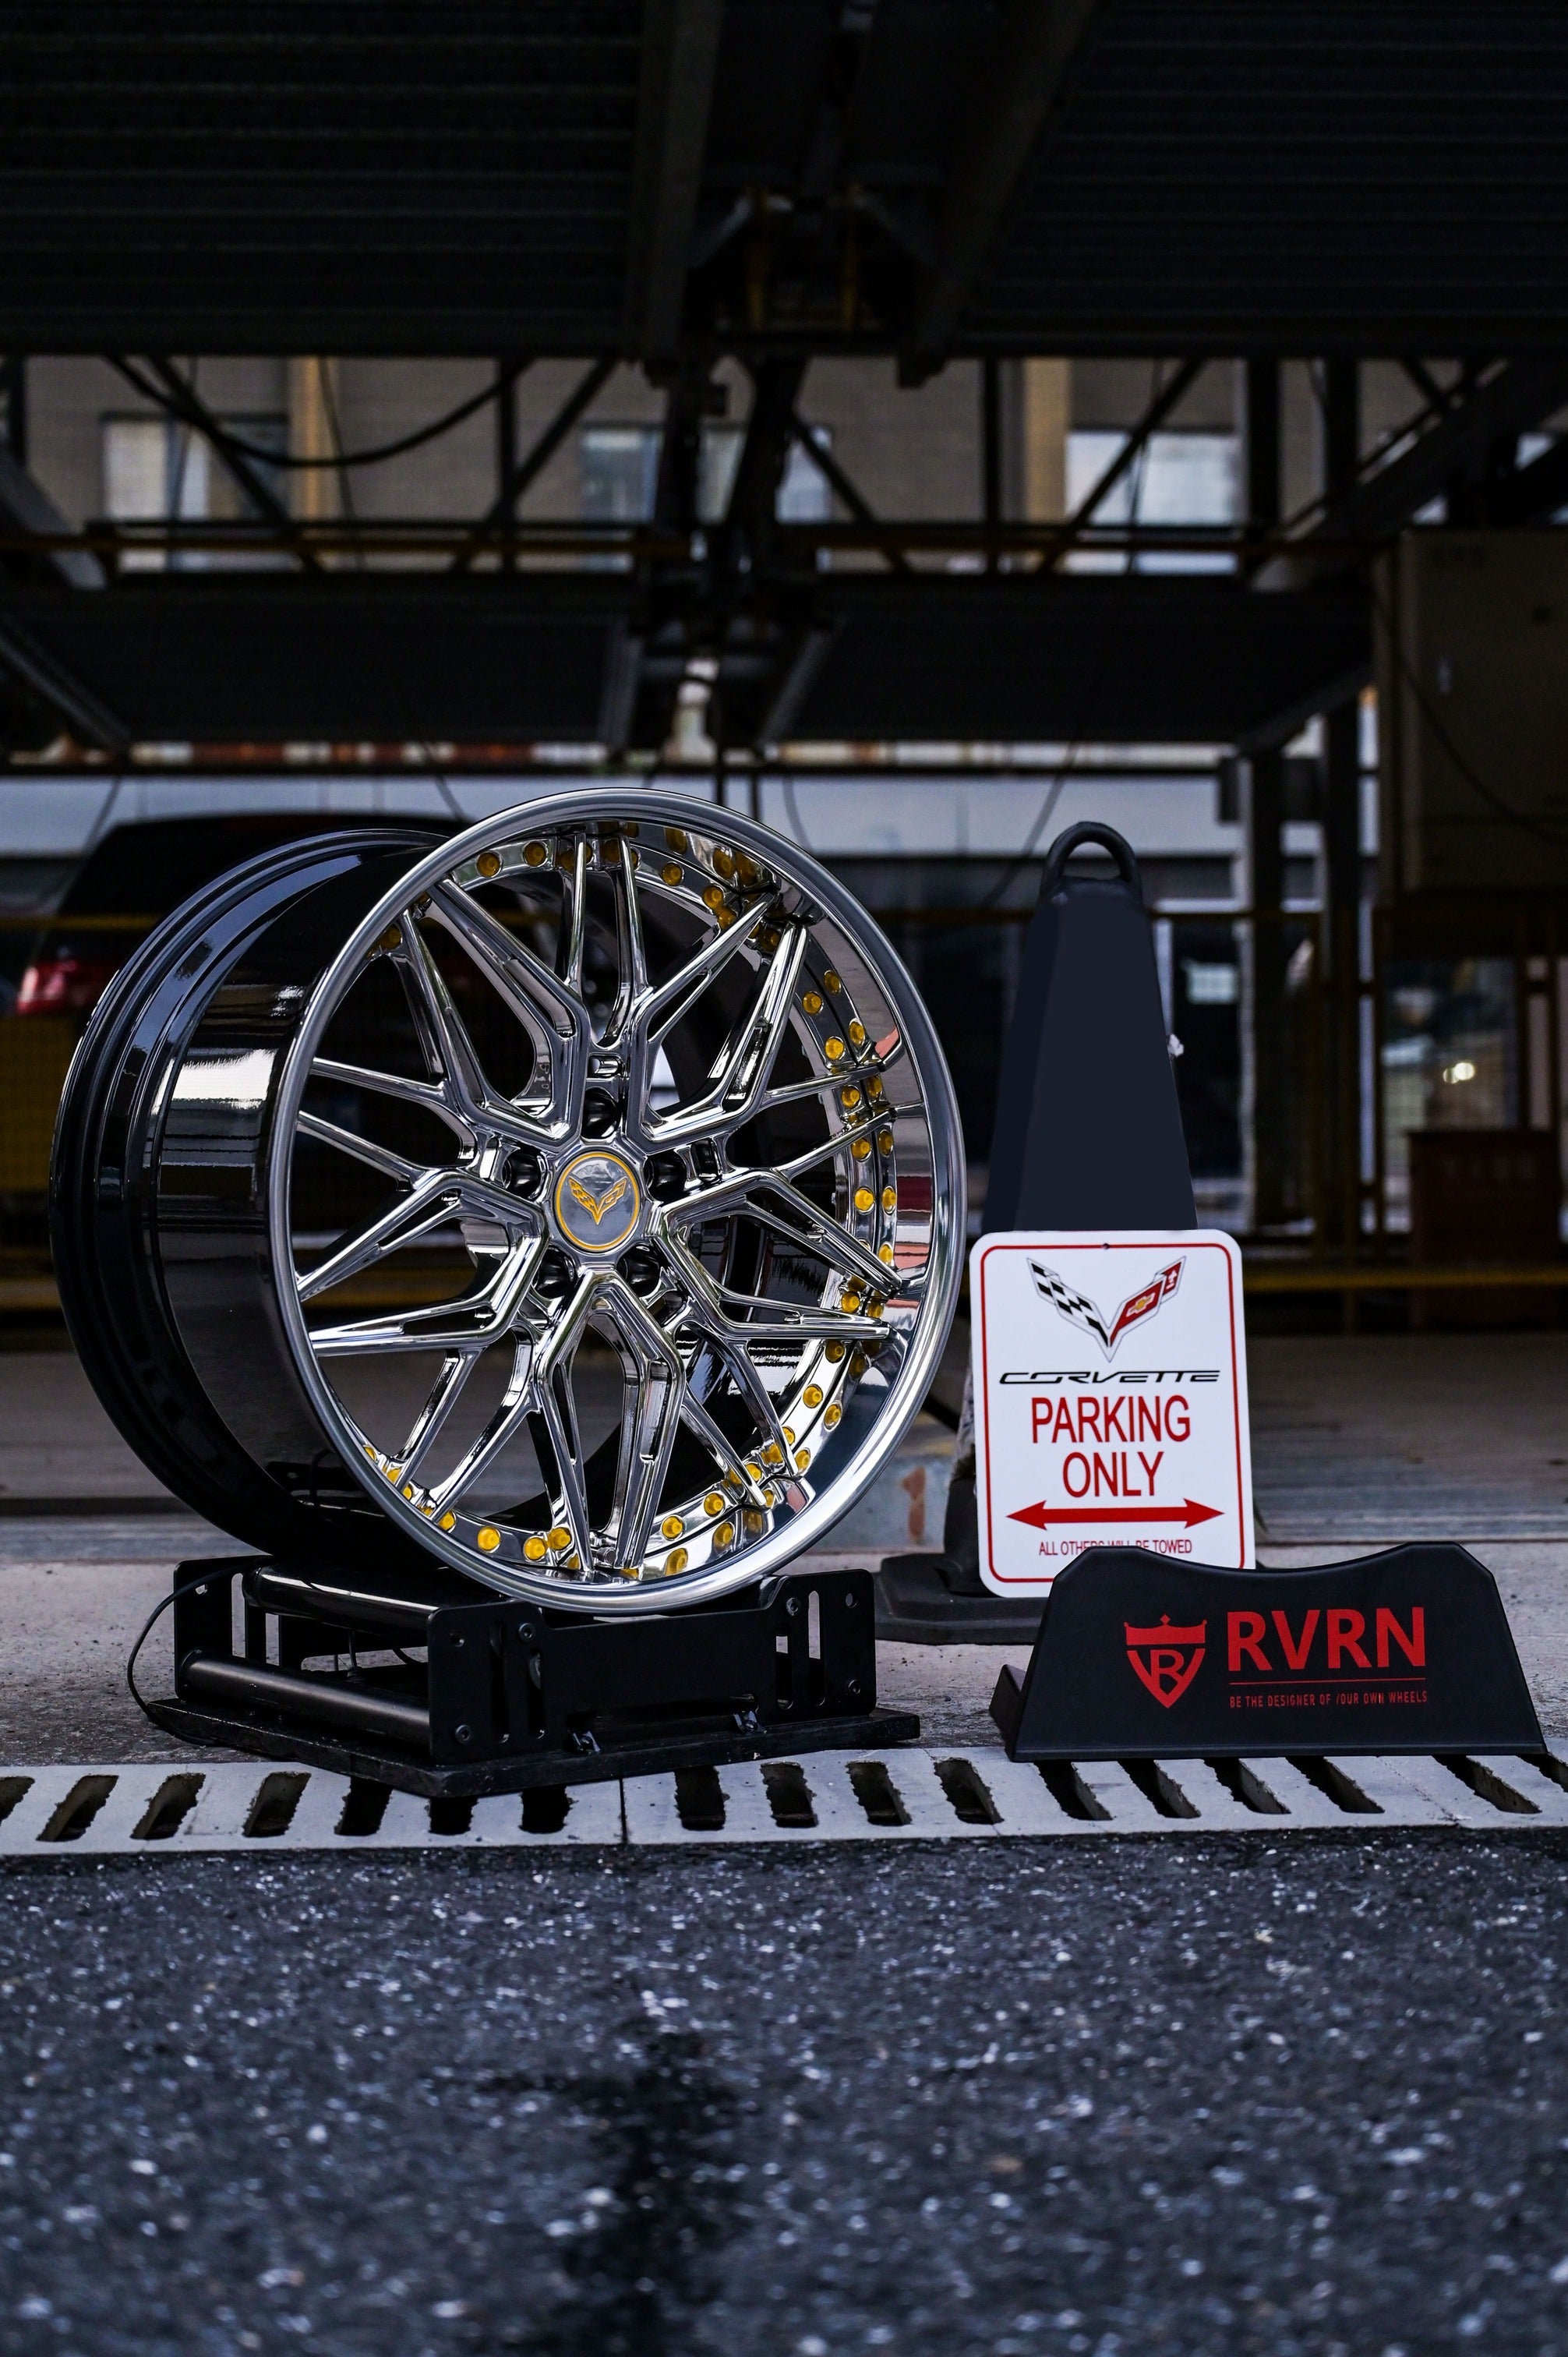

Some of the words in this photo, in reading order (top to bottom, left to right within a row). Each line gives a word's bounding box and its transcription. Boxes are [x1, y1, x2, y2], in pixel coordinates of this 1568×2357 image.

[999, 1369, 1220, 1385] CORVETTE
[1031, 1394, 1191, 1444] PARKING
[1062, 1451, 1164, 1498] ONLY
[1039, 1541, 1058, 1556] ALL
[1153, 1539, 1192, 1553] TOWED
[1227, 1606, 1425, 1672] RVRN
[1229, 1695, 1241, 1708] BE
[1245, 1695, 1263, 1708] THE
[1267, 1693, 1315, 1707] DESIGNER
[1319, 1693, 1330, 1705] OF
[1363, 1691, 1385, 1705] OWN
[1389, 1690, 1428, 1704] WHEELS
